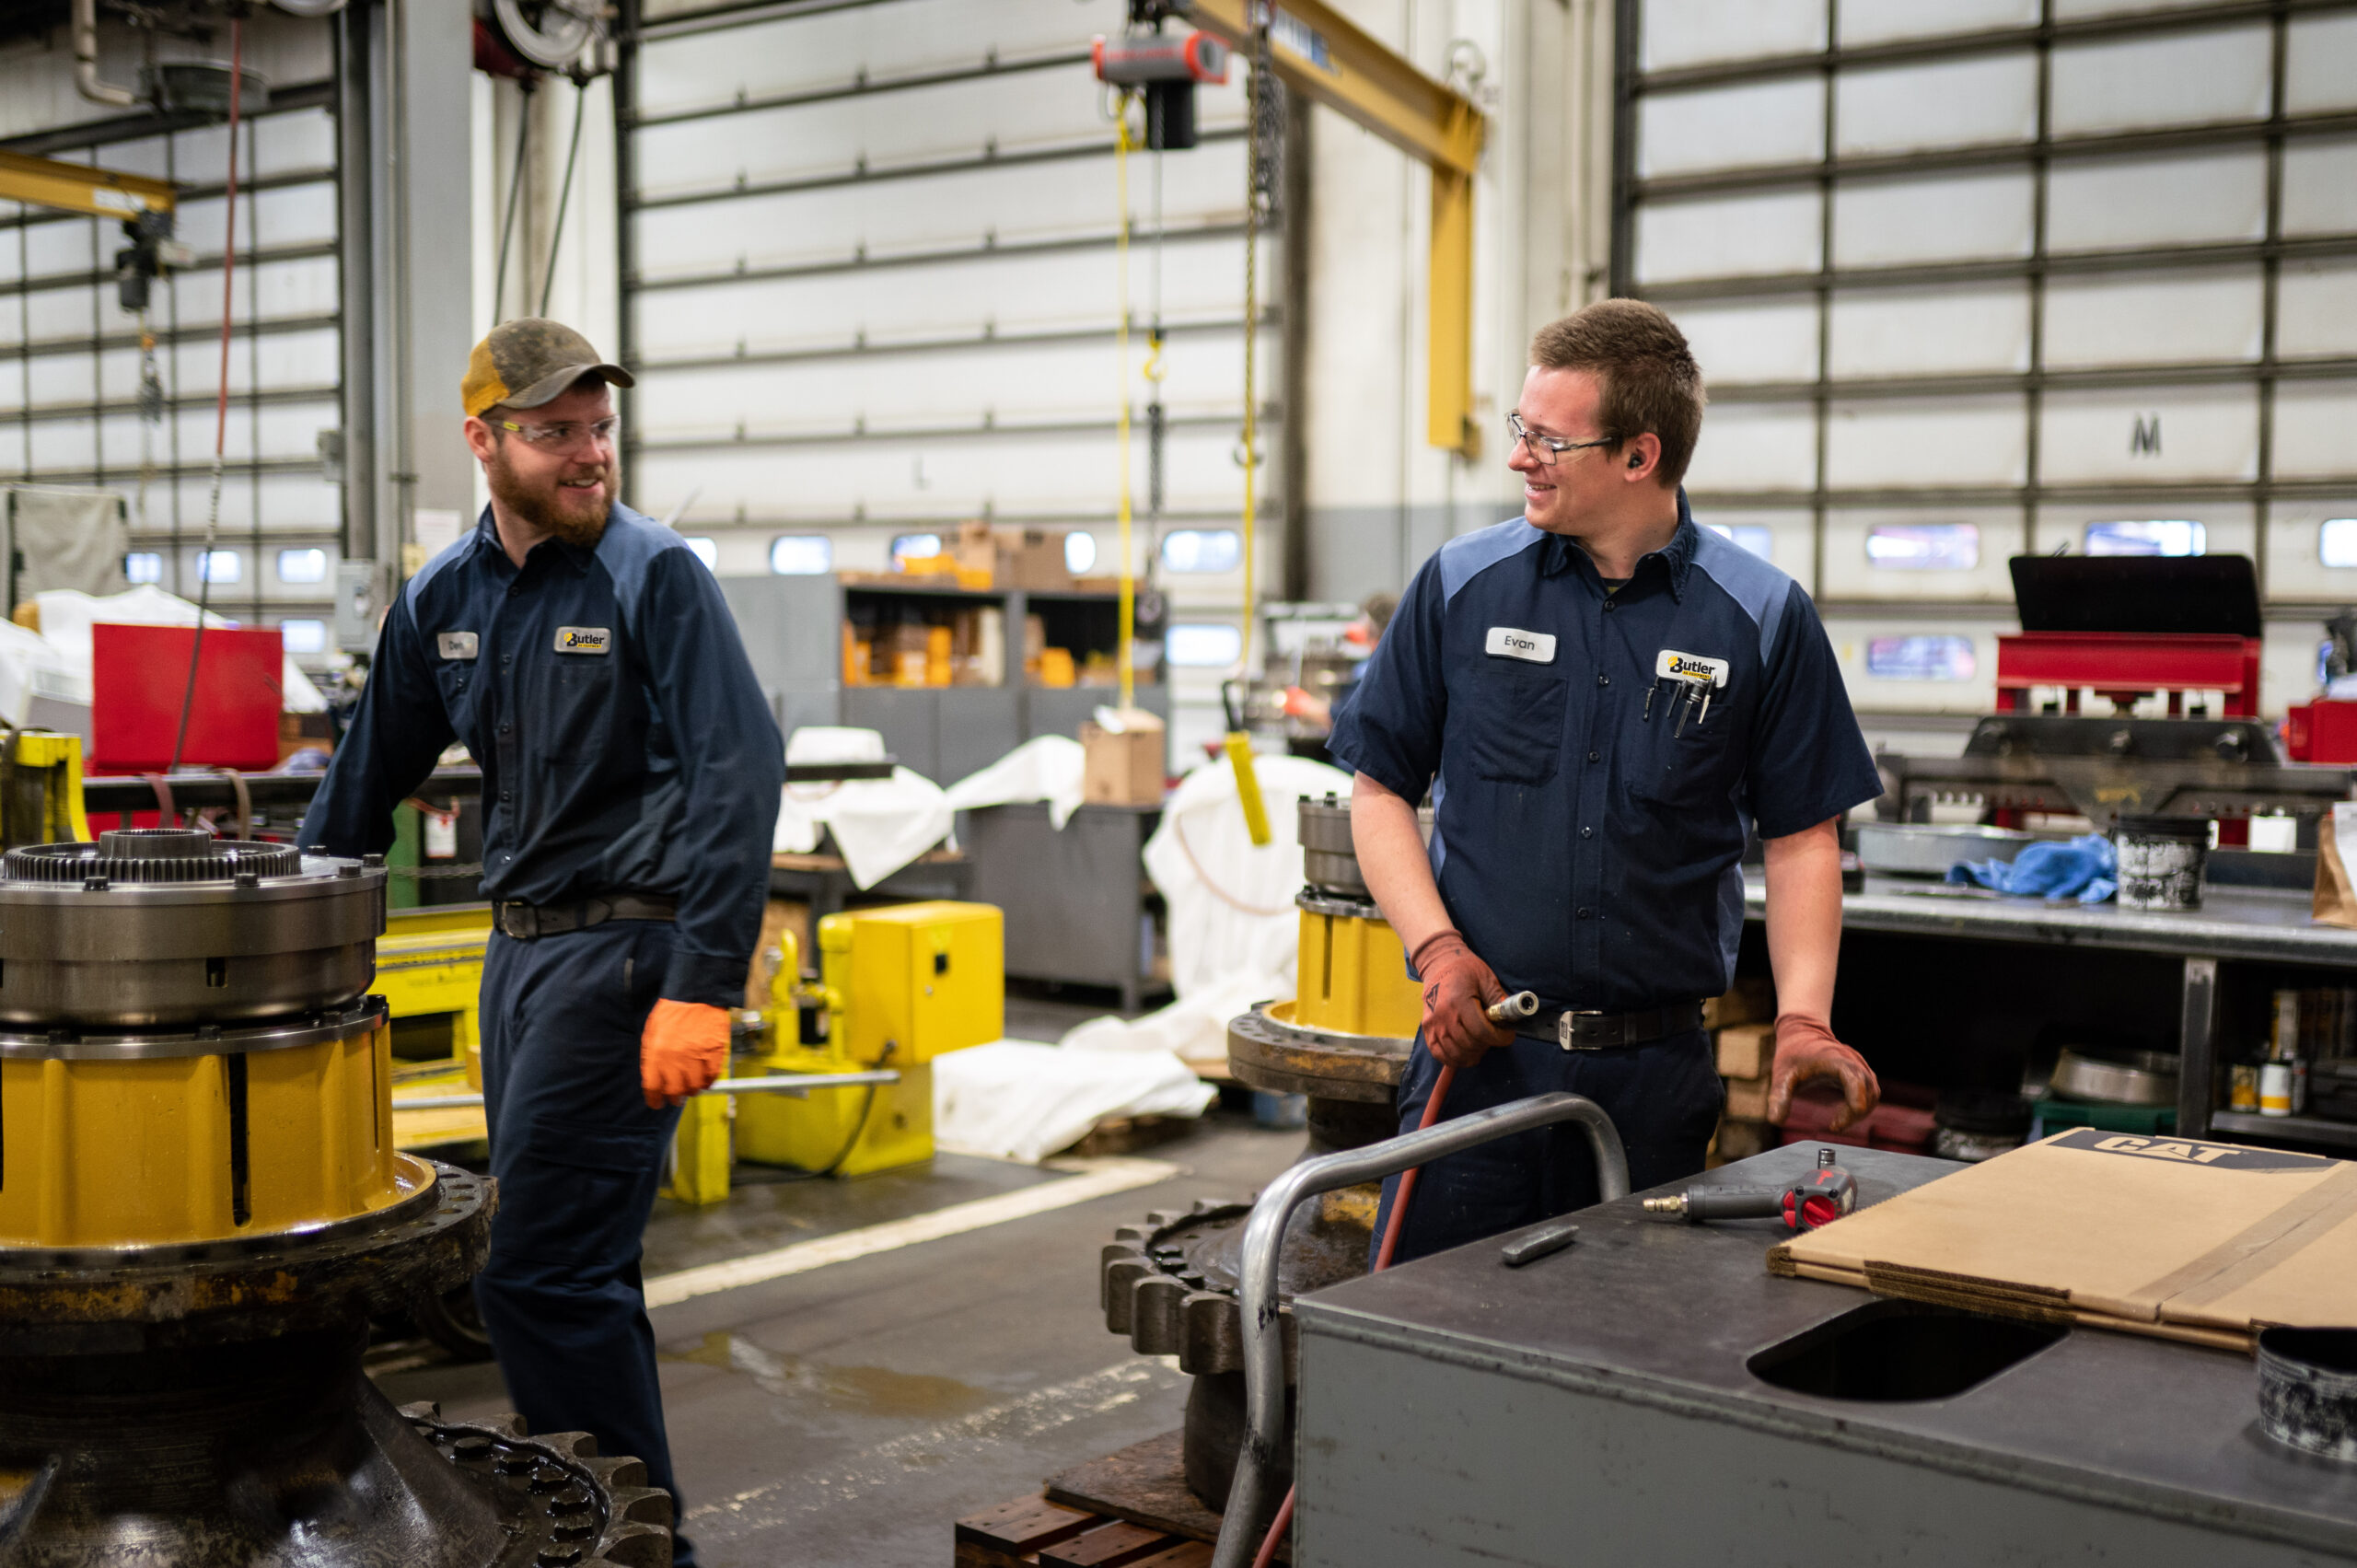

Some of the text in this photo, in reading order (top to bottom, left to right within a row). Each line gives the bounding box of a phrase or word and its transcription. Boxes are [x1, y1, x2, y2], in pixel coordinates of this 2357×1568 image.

[2131, 412, 2161, 456] M
[564, 633, 604, 646] Butler
[1504, 635, 1535, 650] Evan
[1668, 656, 1715, 674] Butler
[2094, 1136, 2241, 1163] CAT
